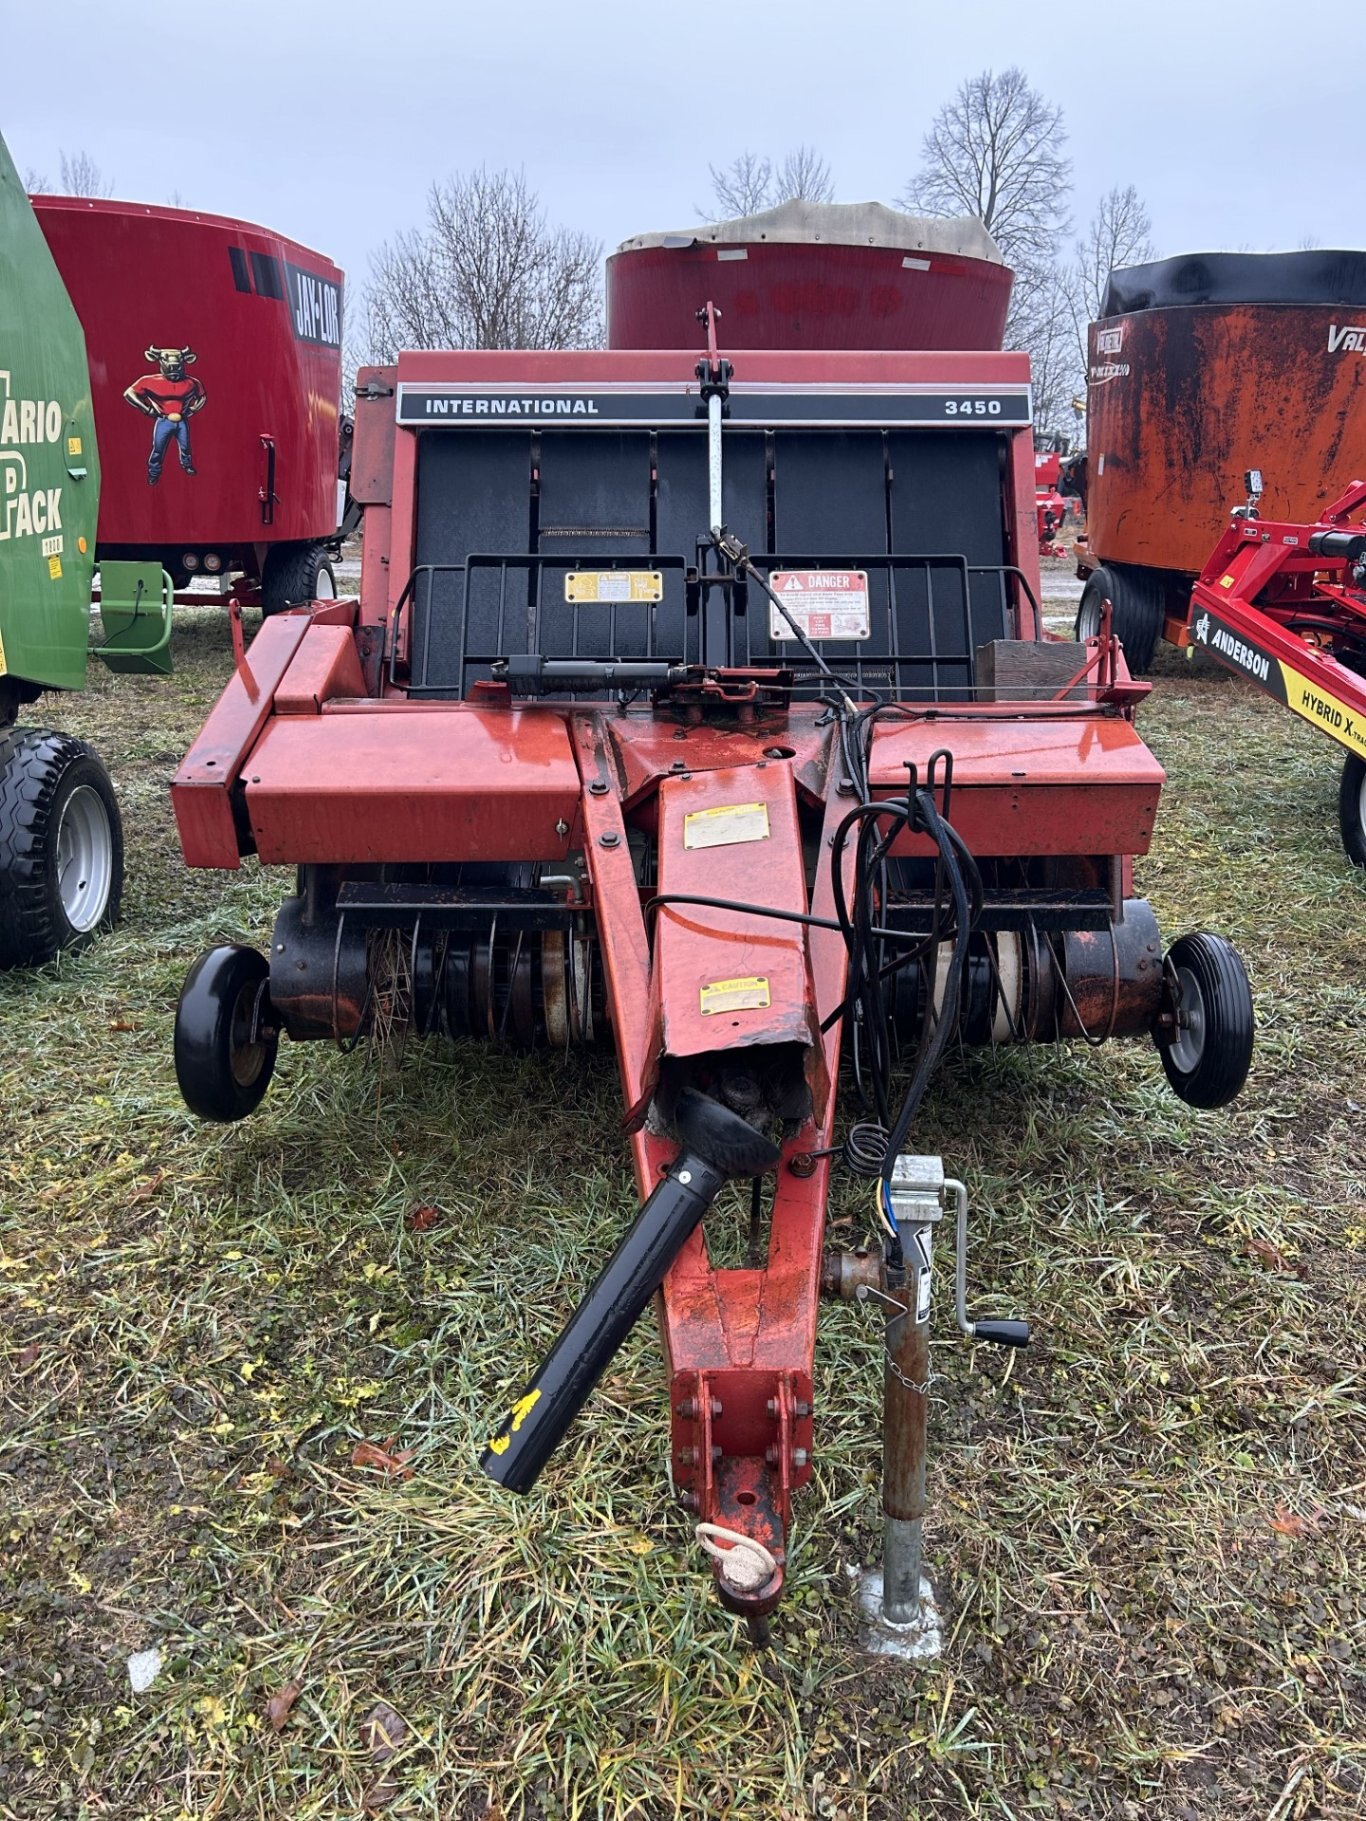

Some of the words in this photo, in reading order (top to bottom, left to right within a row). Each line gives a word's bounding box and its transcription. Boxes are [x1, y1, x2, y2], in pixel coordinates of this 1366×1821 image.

[1328, 325, 1366, 356] VAL
[0, 370, 62, 444] ARIO
[426, 400, 599, 413] INTERNATIONAL
[945, 401, 1001, 414] 3450
[808, 575, 850, 588] DANGER
[1211, 629, 1270, 681] ANDERSON
[1302, 690, 1342, 728] HYBRID
